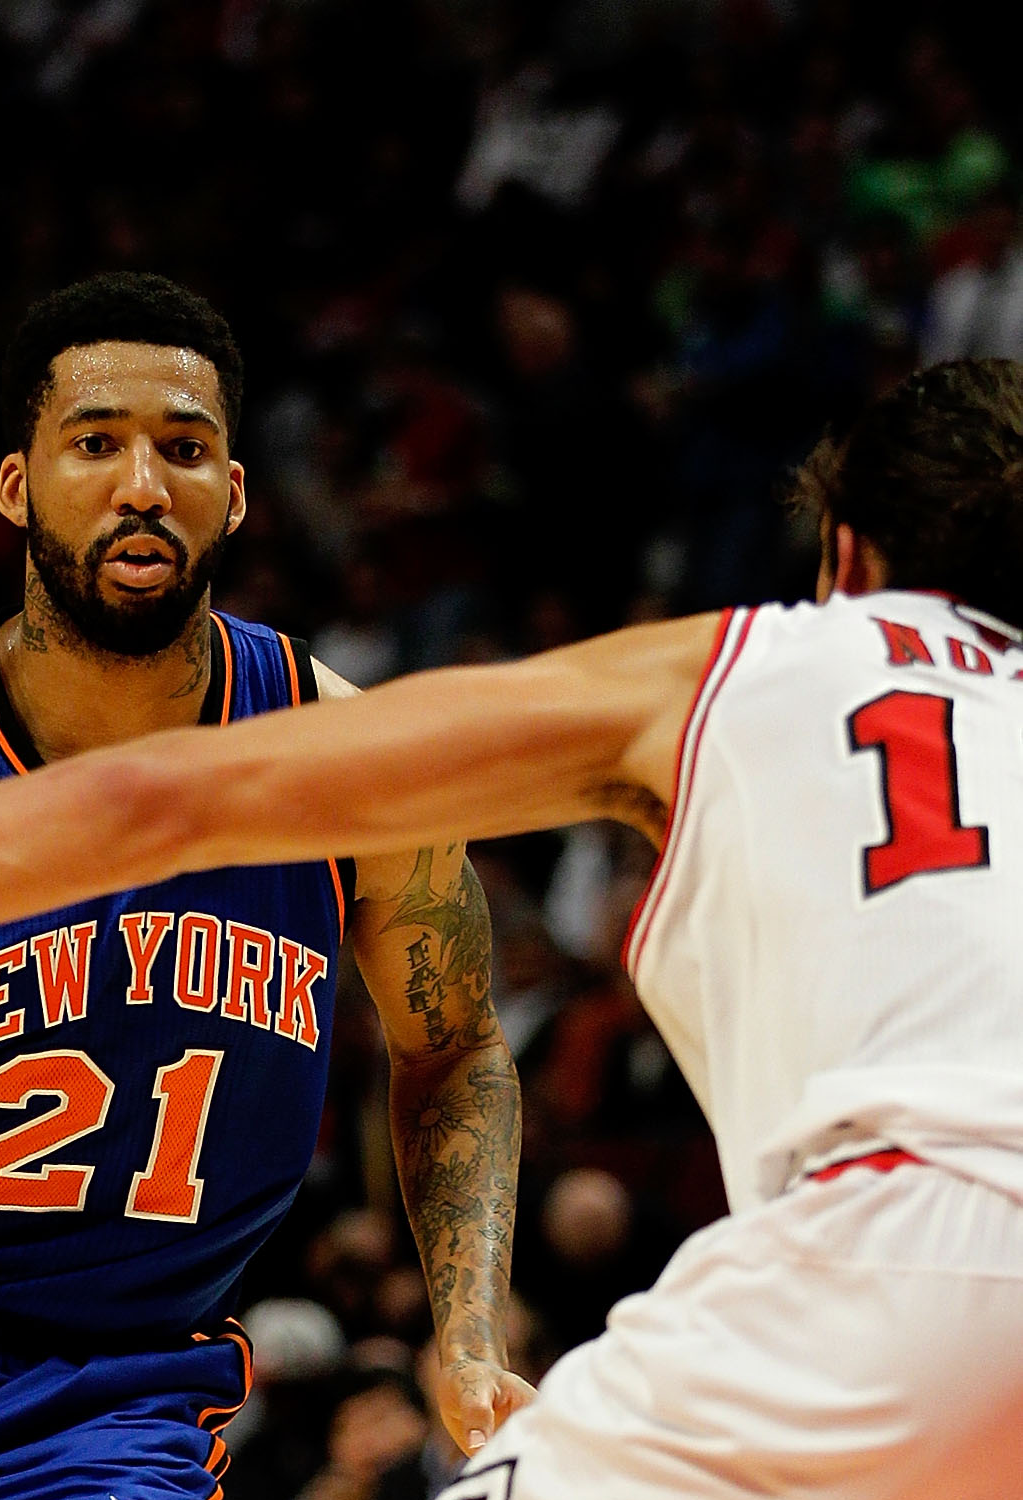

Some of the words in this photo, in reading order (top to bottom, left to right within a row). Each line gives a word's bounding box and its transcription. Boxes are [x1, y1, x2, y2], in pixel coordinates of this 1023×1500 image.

[868, 616, 1023, 681] NO
[846, 689, 991, 897] 1
[118, 911, 329, 1053] YORK
